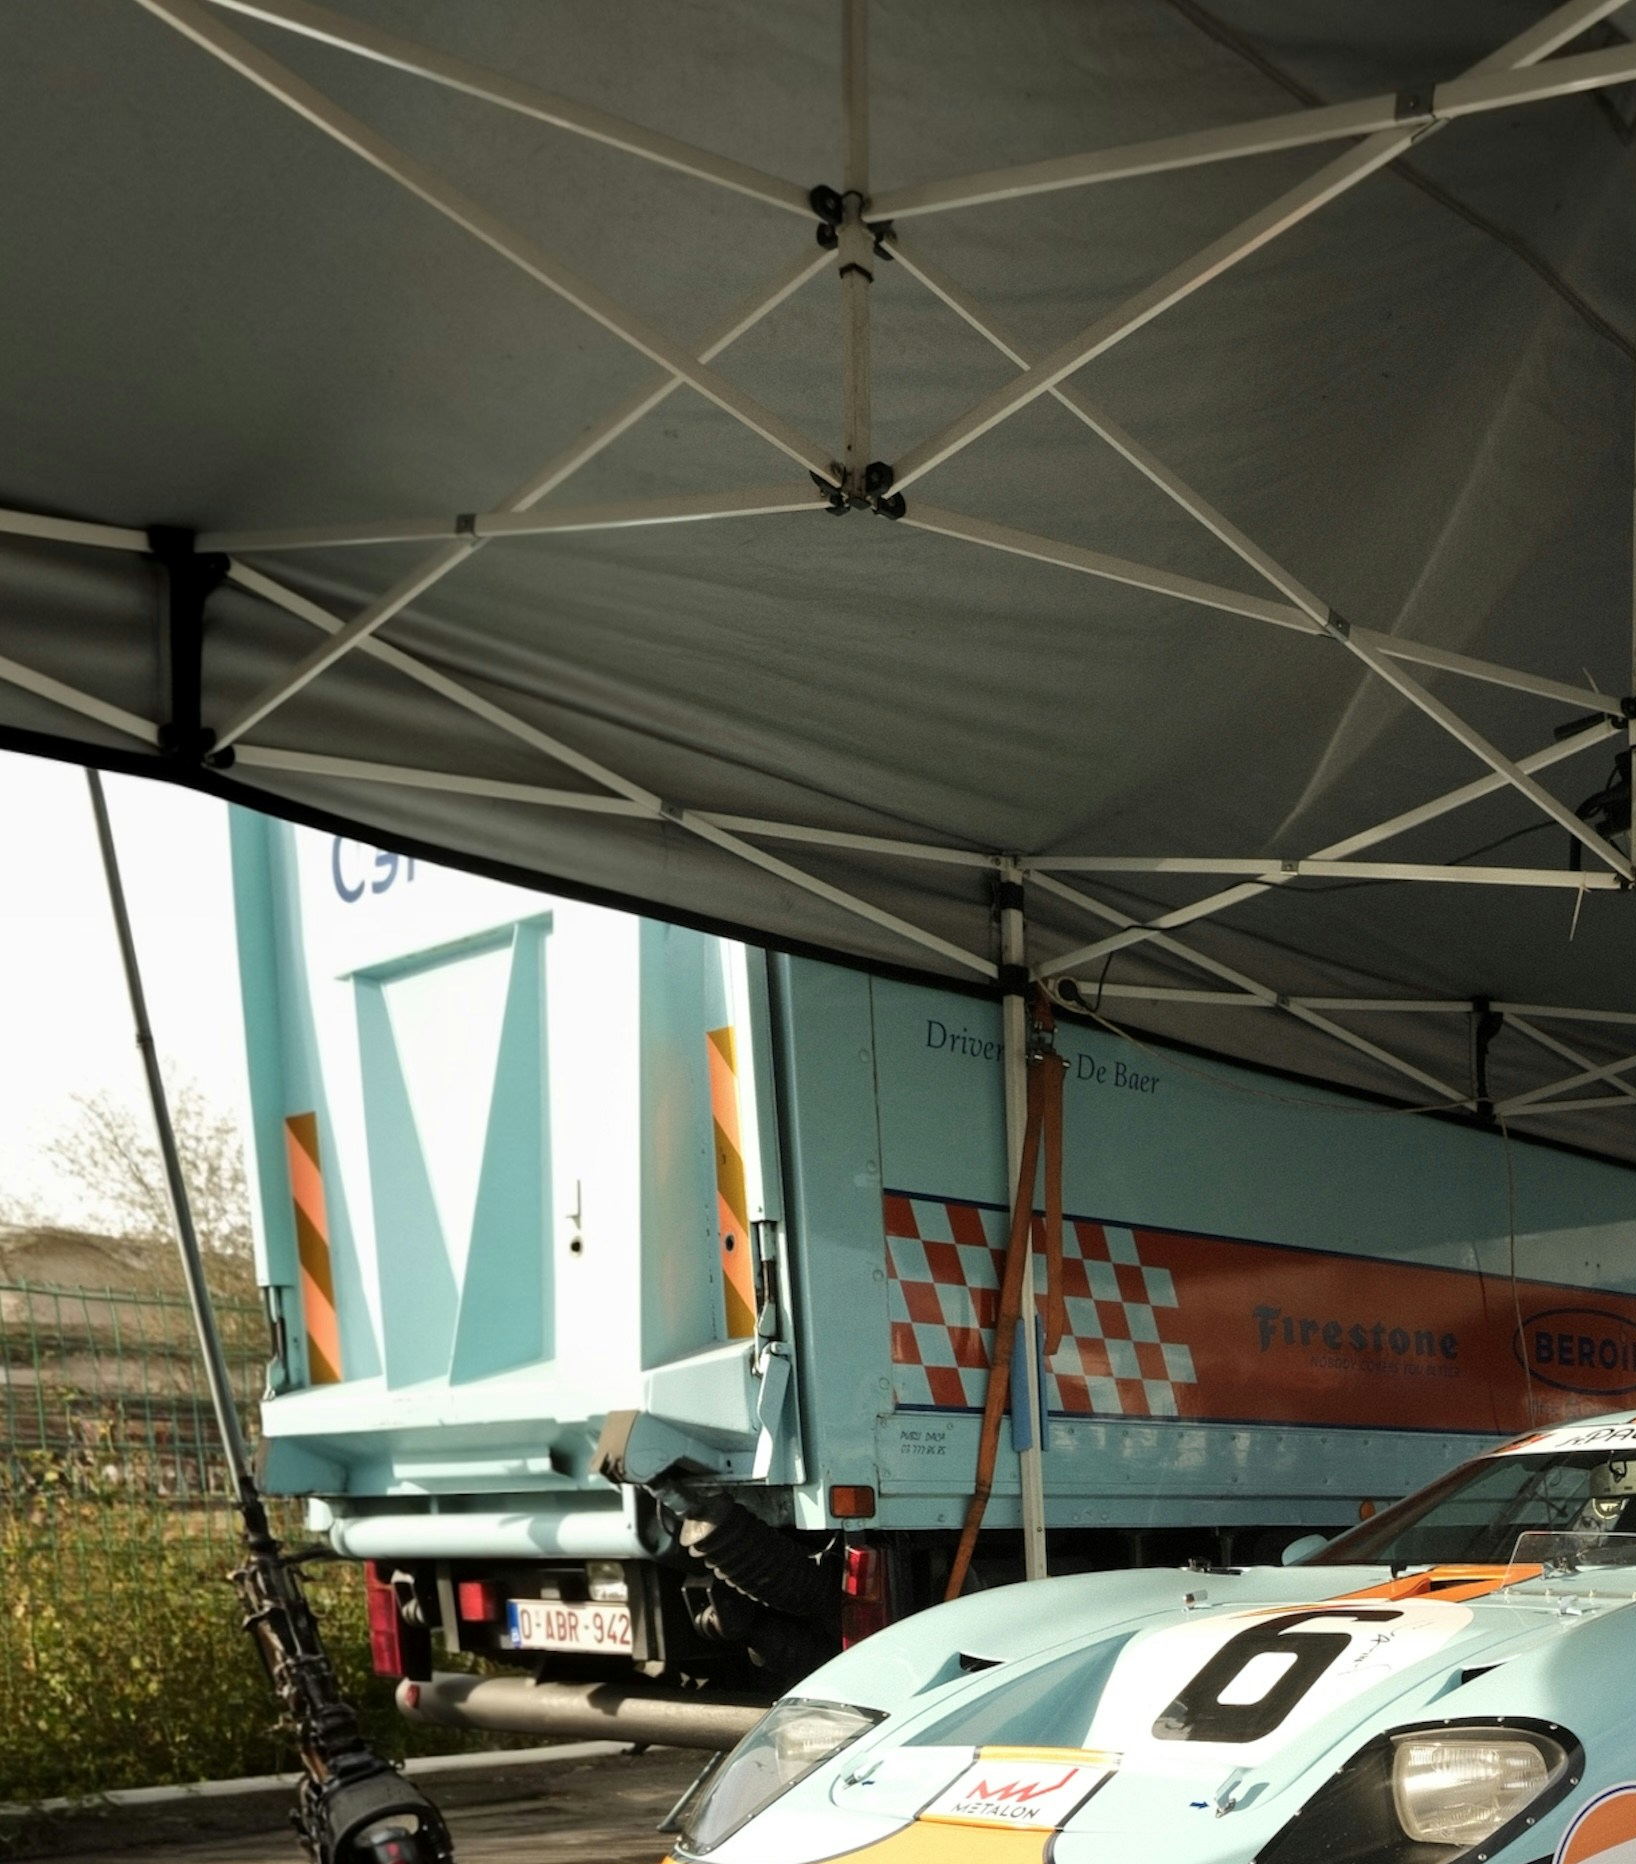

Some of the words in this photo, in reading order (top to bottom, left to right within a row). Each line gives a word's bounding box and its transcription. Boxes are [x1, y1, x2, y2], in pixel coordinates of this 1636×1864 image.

[1076, 1053, 1106, 1084] De
[1114, 1061, 1161, 1093] Baer
[1252, 1304, 1459, 1361] Firestone
[1151, 1609, 1405, 1745] 6
